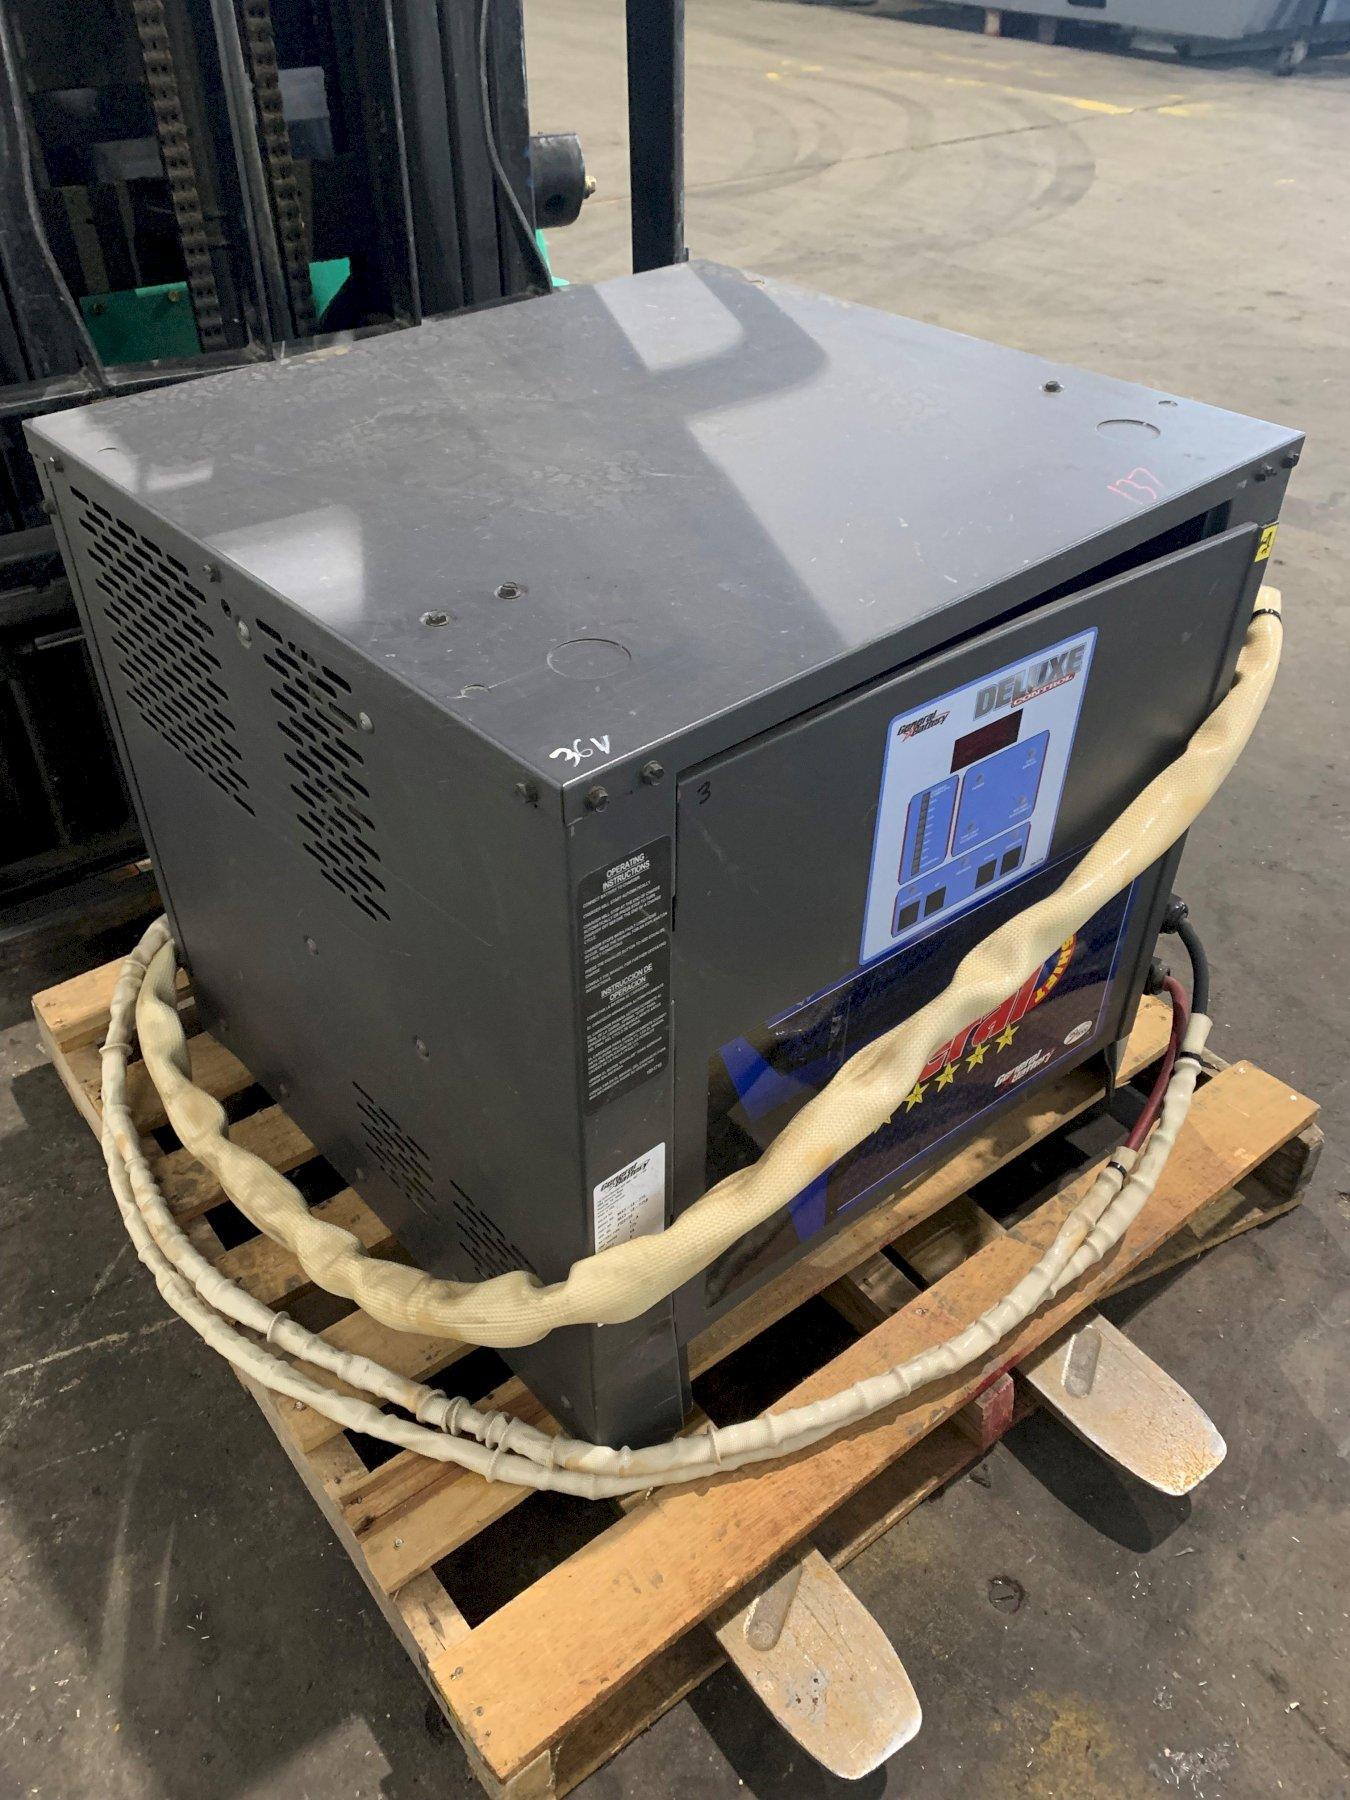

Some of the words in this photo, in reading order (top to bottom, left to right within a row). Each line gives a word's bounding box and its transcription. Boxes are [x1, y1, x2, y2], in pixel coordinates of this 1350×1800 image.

[973, 642, 1088, 721] DELUXE
[1013, 673, 1075, 706] CONTROL
[897, 710, 938, 736] General
[911, 713, 950, 737] Battery
[602, 860, 650, 890] INSTRUCTIONS
[606, 853, 645, 878] OPERATING
[601, 968, 643, 996] INSTRUCCION
[643, 962, 653, 974] DE
[609, 976, 646, 1000] OPERACION
[994, 1049, 1043, 1087] General
[1011, 1049, 1055, 1083] Battery
